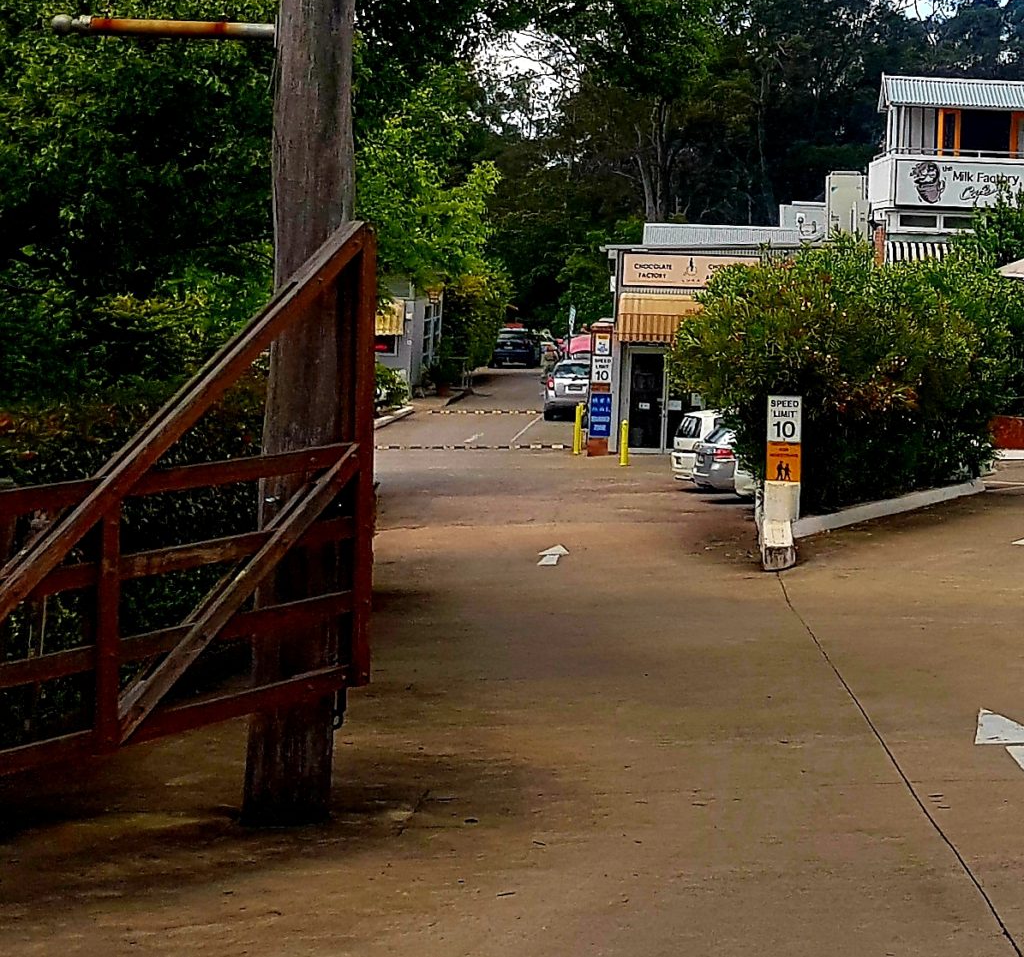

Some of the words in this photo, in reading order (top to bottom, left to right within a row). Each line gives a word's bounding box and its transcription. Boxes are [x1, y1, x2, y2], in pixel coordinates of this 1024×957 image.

[953, 171, 974, 182] Milk
[596, 371, 609, 381] 10
[770, 399, 799, 408] SPEED
[773, 410, 797, 418] LIMIT
[773, 421, 796, 438] 10
